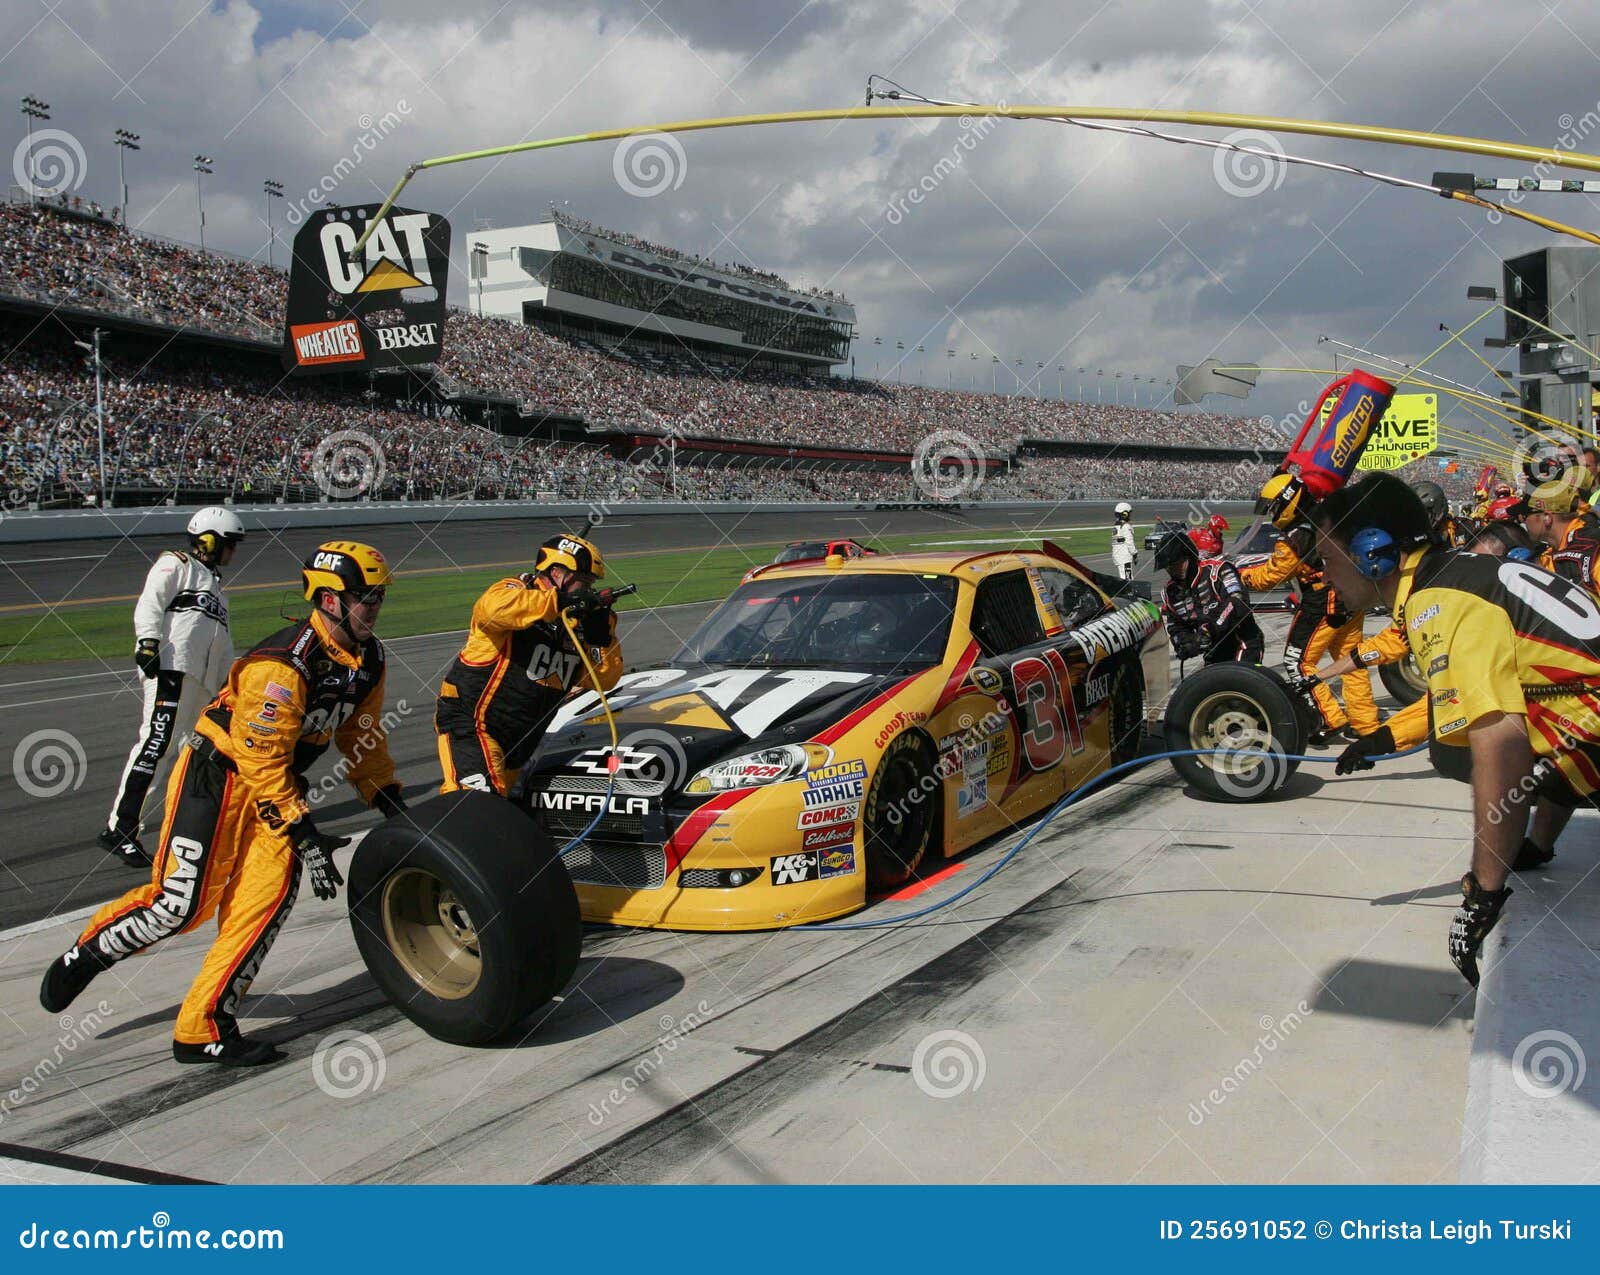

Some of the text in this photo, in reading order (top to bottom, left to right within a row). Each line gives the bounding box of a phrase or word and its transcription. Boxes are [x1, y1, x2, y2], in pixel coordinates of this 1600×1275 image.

[320, 213, 433, 294] CAT
[611, 251, 823, 316] DAYTONA
[297, 323, 360, 359] WHEATIES
[376, 323, 437, 350] BB&T
[1333, 397, 1373, 466] SUNOCO
[1376, 442, 1430, 451] HUNGER
[558, 538, 584, 556] CAT
[313, 552, 344, 571] CAT
[526, 644, 581, 692] CAT
[545, 668, 872, 739] CAT
[1011, 649, 1085, 771] 31
[151, 712, 171, 759] Sprint
[874, 711, 927, 749] GOODYEAR
[743, 765, 781, 777] RCR
[807, 761, 864, 782] MOOG
[531, 792, 649, 815] IMPALA
[803, 780, 863, 805] MAHLE
[801, 806, 846, 825] COMP
[805, 828, 852, 846] Edelbrock
[822, 854, 852, 866] SUNOCO
